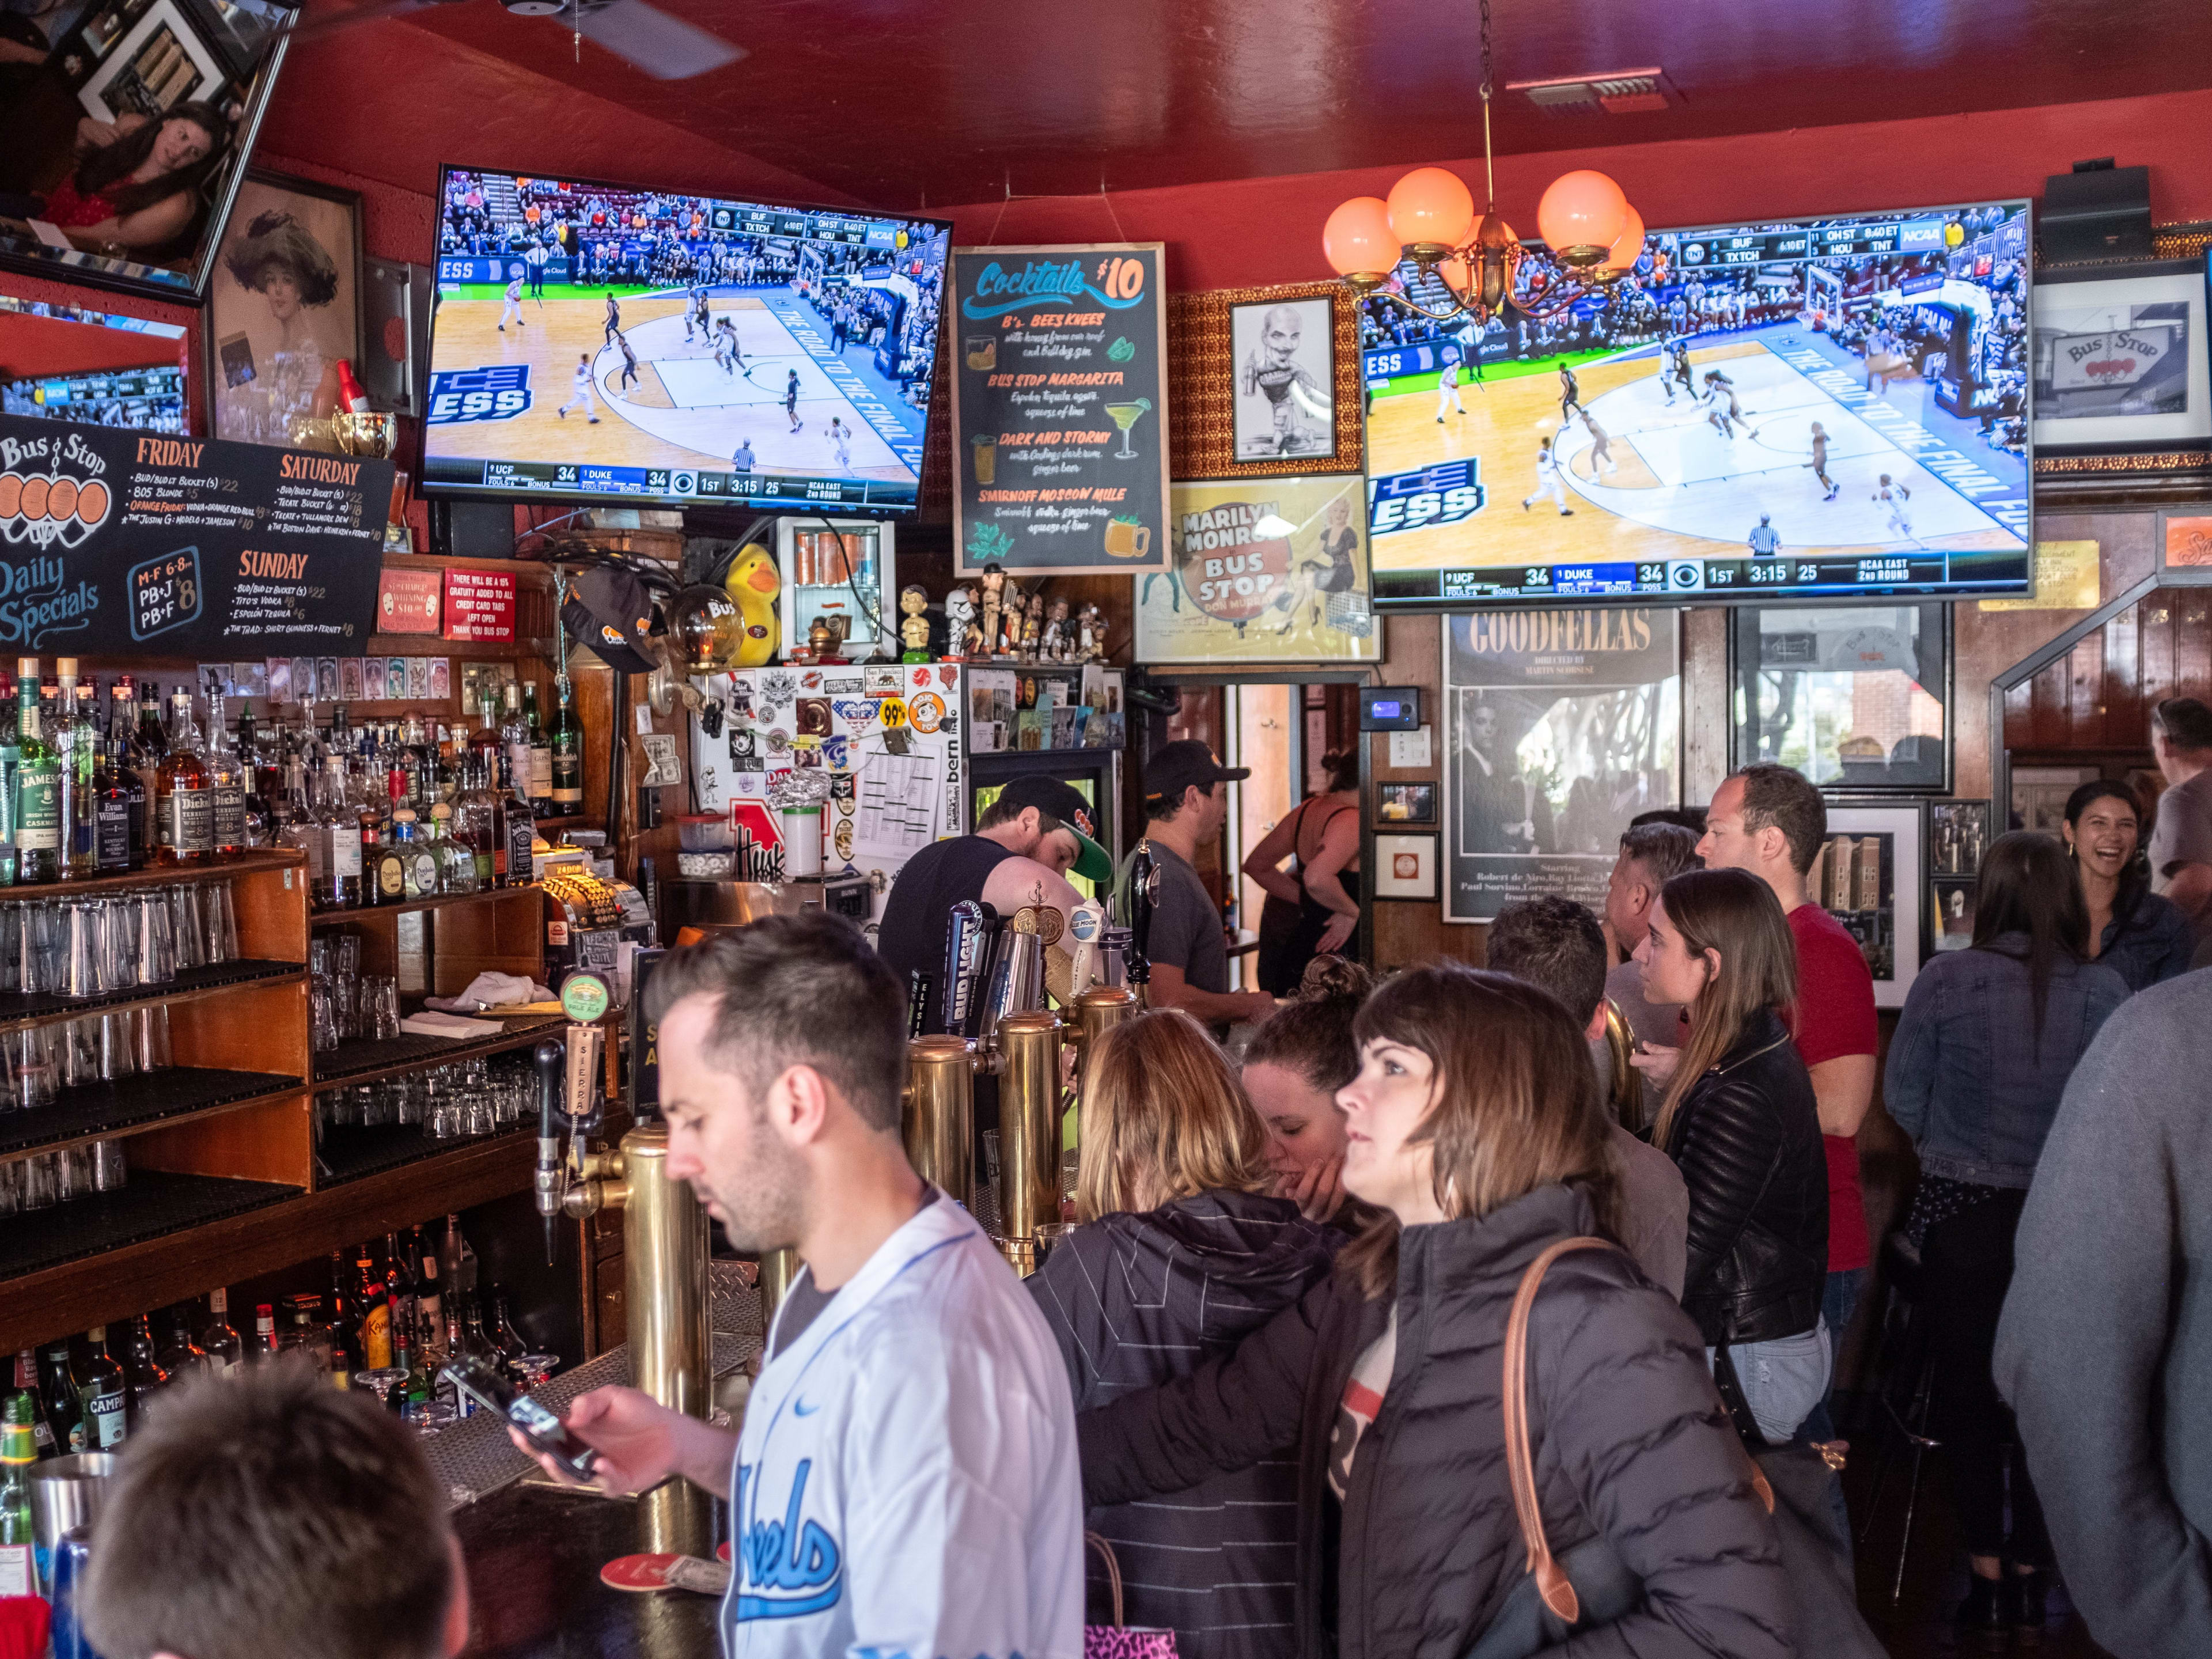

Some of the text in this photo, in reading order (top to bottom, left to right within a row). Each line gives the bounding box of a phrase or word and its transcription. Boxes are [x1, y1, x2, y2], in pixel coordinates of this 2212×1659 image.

[751, 212, 766, 221] BUF
[819, 230, 893, 243] HOU TNT NCAA
[1731, 237, 1753, 249] BUF
[1831, 229, 1940, 255] HOU TNT NCAA
[976, 257, 1145, 299] Cocktails $10
[1030, 312, 1106, 328] BEES KNEES
[776, 309, 914, 441] THE ROAD TO THE FINAL
[987, 371, 1124, 388] BUS STOP MARGARITA
[1782, 348, 2011, 498] THE ROAD TO THE FINAL
[999, 430, 1112, 446] DARK AND STORMY
[0, 433, 107, 476] Bus Stop
[136, 438, 205, 468] FRIDAY
[279, 454, 362, 486] SATURDAY
[179, 476, 238, 493] BUCKET $22
[495, 465, 841, 495] UCF 34 DUKE 34 1ST 3:15 25 NCAA EAST
[134, 486, 184, 498] 805 BLONDE
[312, 487, 334, 498] BUCKET
[619, 484, 642, 493] BONUS
[806, 489, 819, 498] 2ND
[819, 490, 841, 500] ROUND
[979, 487, 1127, 503] SMIRNOFF MOSCOW MULE
[130, 500, 255, 517] ORANGE BULL
[277, 497, 325, 510] TECATE BUCKET
[128, 513, 254, 531] THE JUSTIN MODELO JAMESON $10
[274, 510, 350, 524] TECATE TULLAMORE DEW
[1181, 501, 1280, 535] MARILYN
[282, 523, 305, 534] BOSTON
[238, 550, 309, 579] SUNDAY
[1204, 552, 1264, 578] BUS
[1453, 559, 1908, 586] UCF 34 DUKE 34 1ST 3:15 25 NCAA EAST
[0, 556, 64, 605] Daily
[138, 566, 161, 586] M-F
[453, 574, 498, 586] THERE WILL BE A
[1493, 569, 1910, 596] BONUS BONUS POSS 2ND ROUND
[139, 579, 173, 607] PB+J
[273, 585, 326, 599] BUCKET $22
[449, 586, 513, 600] GRATUITY ADDED TO ALL
[1199, 574, 1275, 601] STOP
[236, 596, 282, 605] TITO'S VODKA
[456, 600, 505, 612] CREDIT CARD TABS
[1205, 594, 1272, 612] DON MURRAY
[0, 580, 99, 647] Specials
[141, 600, 175, 629] PB+F
[264, 609, 291, 619] TEQUILA
[467, 612, 495, 623] LEFT OPEN
[264, 624, 342, 634] SHORT GUINNESS FERNET
[452, 624, 510, 637] THANK YOU BUS STOP
[1470, 611, 1651, 654] GOODFELLAS
[1525, 666, 1555, 675] MARTIN
[911, 694, 933, 709] MOJO
[21, 774, 58, 789] JAMES
[104, 802, 123, 812] Evan
[98, 812, 128, 821] Williams
[1476, 872, 1509, 881] Robert
[954, 921, 975, 1020] BUD LIGHT
[914, 983, 927, 1037] ELYSIA
[577, 1046, 586, 1109] SIERRA
[90, 1393, 126, 1414] CAMPA
